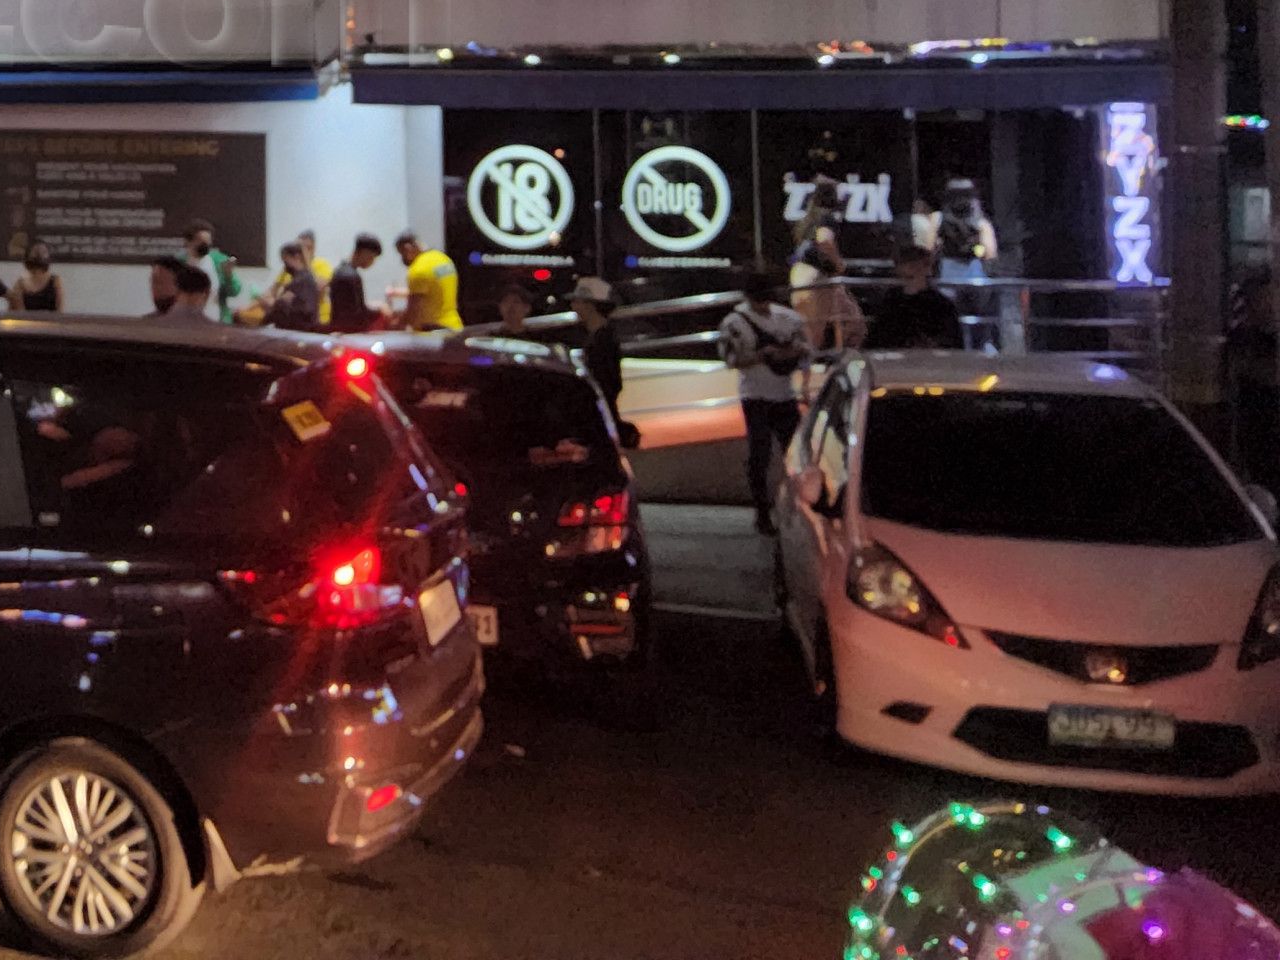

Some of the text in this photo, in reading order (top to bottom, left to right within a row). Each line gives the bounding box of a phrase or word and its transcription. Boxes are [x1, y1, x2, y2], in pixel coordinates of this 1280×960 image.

[490, 162, 552, 231] 18
[636, 182, 703, 215] DRUG
[783, 172, 893, 223] ZZX
[1109, 102, 1153, 282] ZYZX
